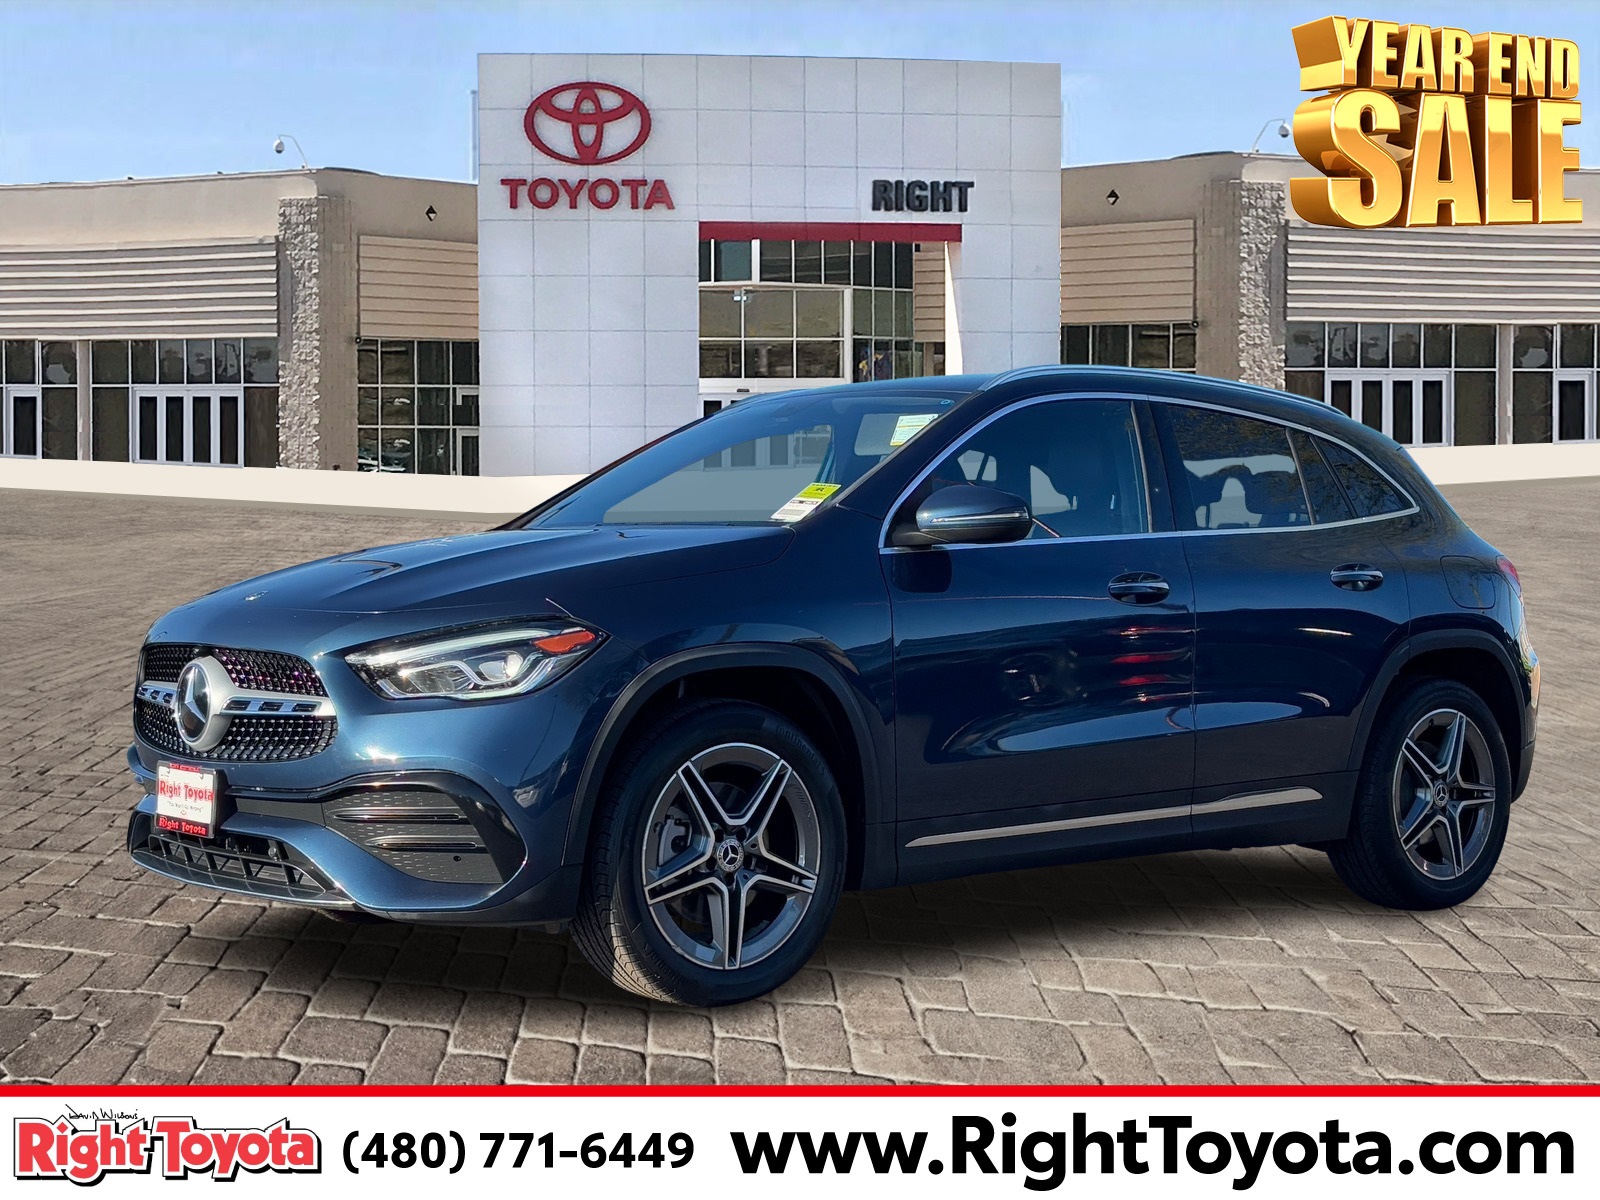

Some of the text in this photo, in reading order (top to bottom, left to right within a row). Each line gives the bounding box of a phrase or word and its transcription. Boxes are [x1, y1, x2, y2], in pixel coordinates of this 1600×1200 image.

[501, 178, 674, 210] TOYOTA
[872, 179, 975, 212] RIGHT
[159, 780, 214, 802] Right Toyota
[159, 817, 206, 835] Right Toyota
